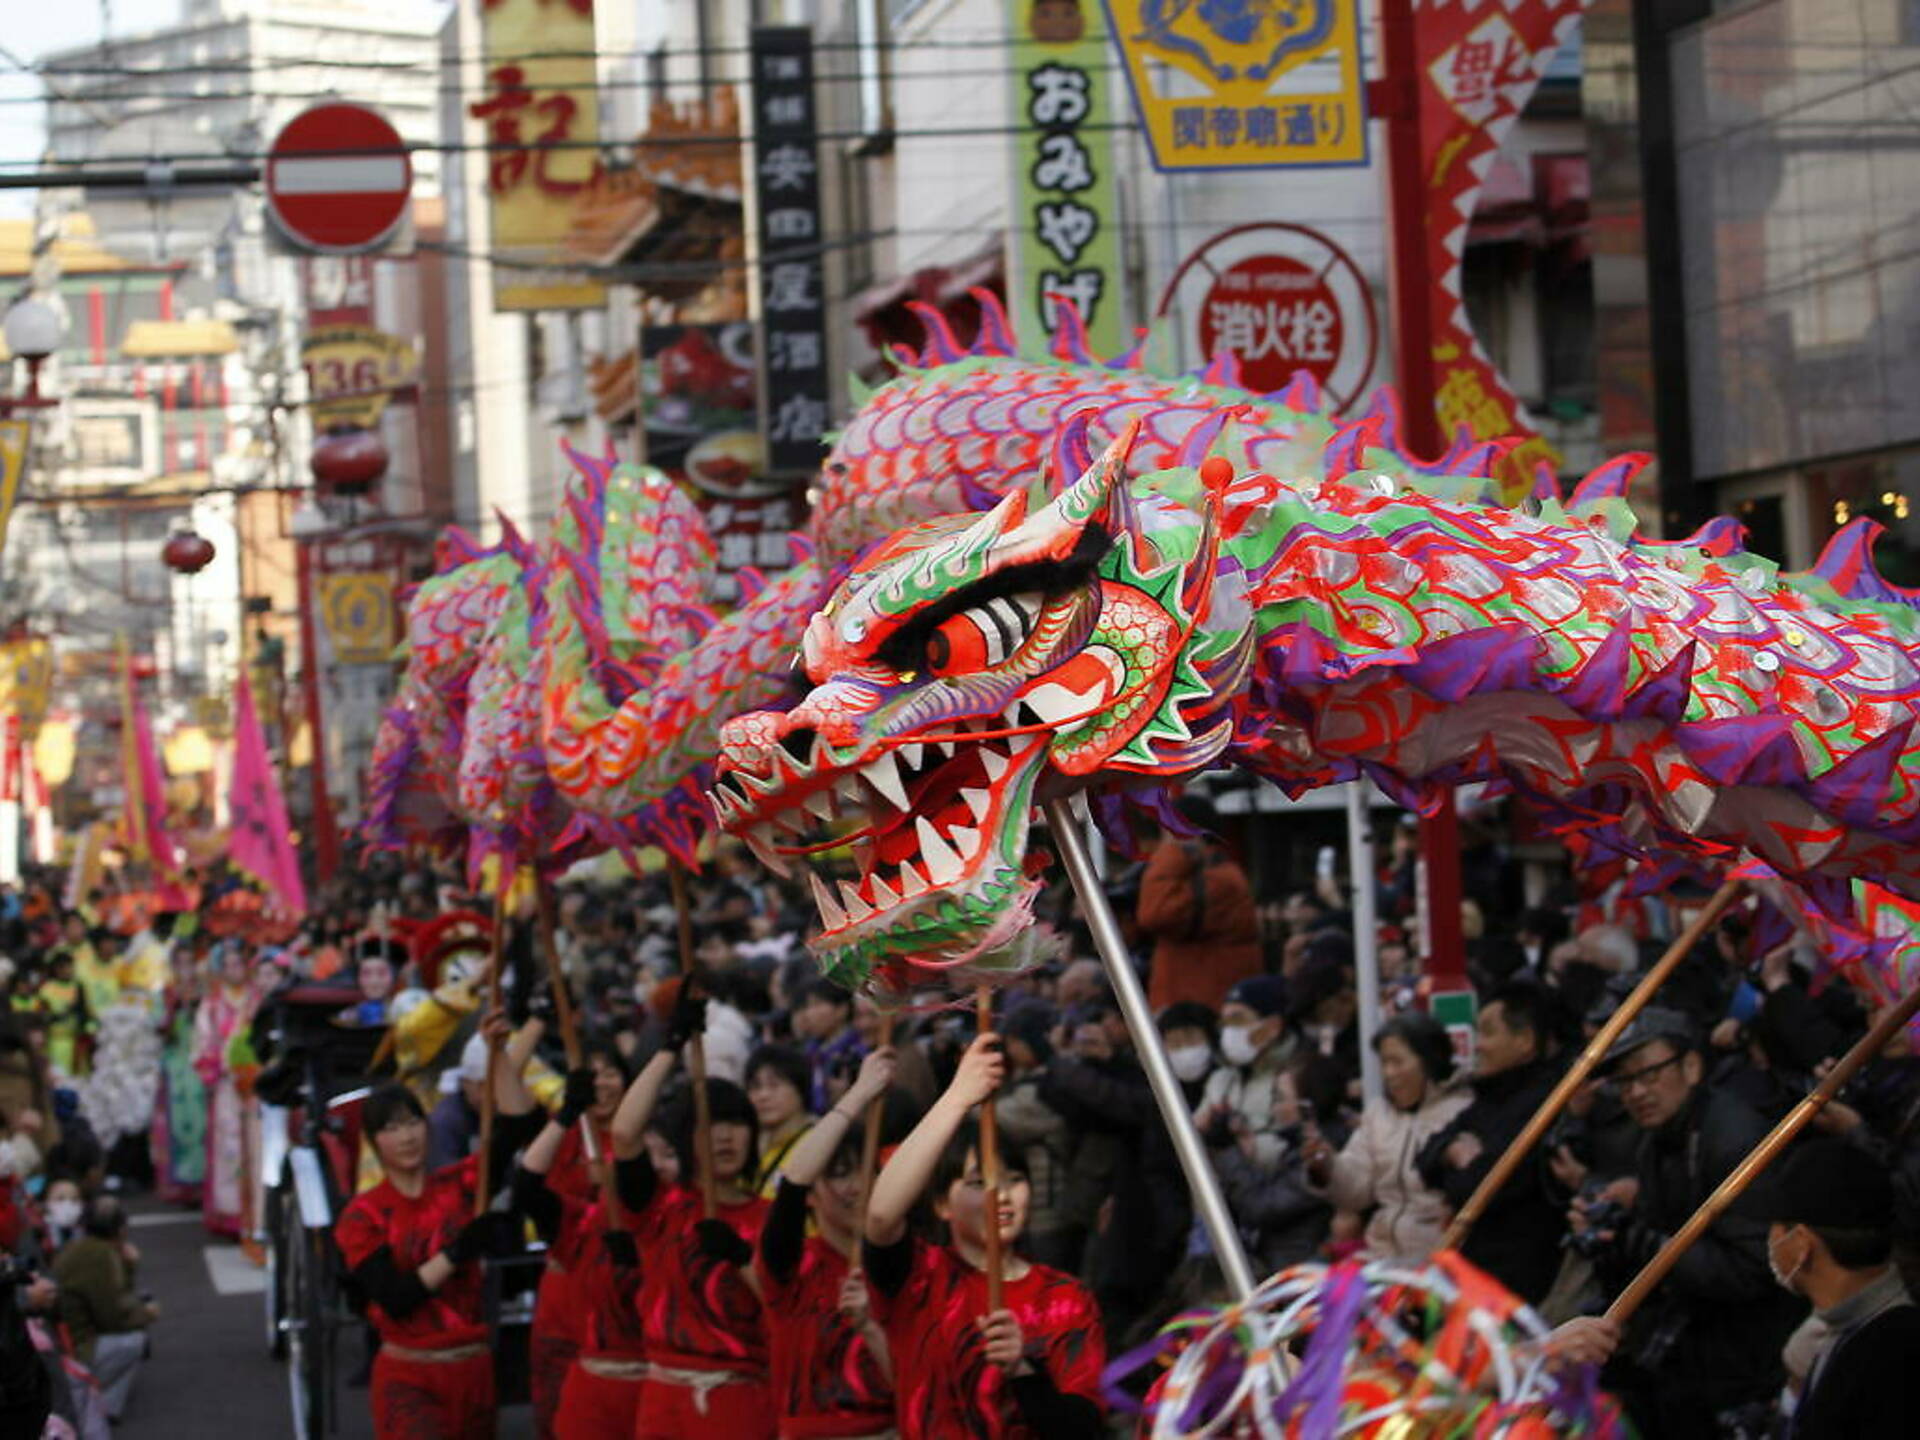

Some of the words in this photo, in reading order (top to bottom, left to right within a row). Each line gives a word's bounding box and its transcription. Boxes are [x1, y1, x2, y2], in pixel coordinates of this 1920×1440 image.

[760, 57, 826, 441] 安田屋酒店
[1030, 64, 1103, 333] おみやげ
[1210, 300, 1335, 361] 消火栓
